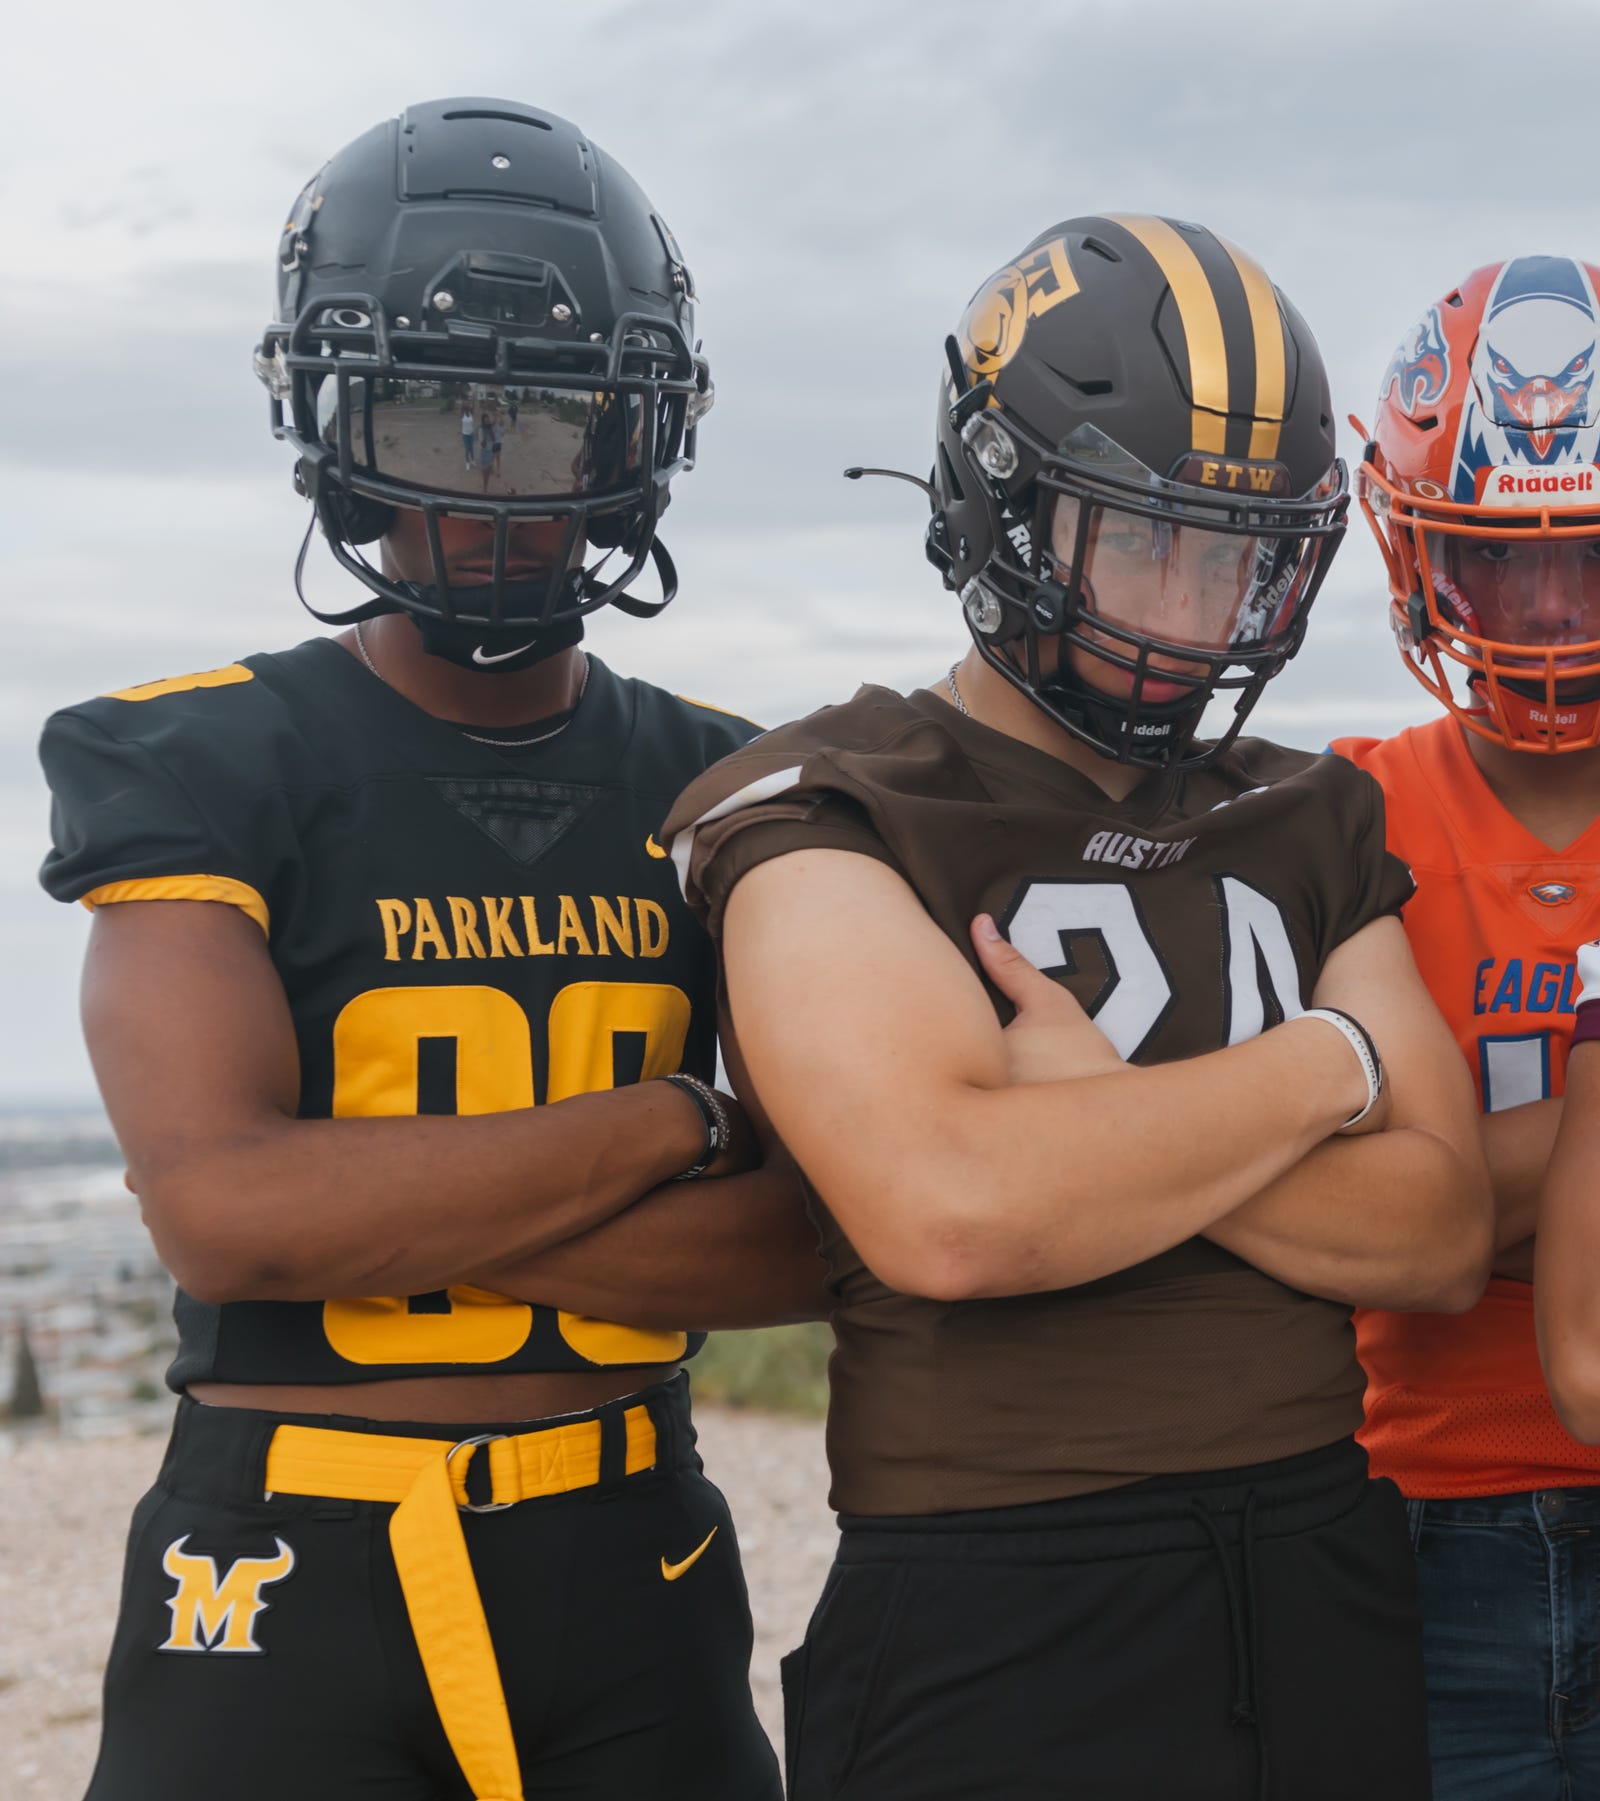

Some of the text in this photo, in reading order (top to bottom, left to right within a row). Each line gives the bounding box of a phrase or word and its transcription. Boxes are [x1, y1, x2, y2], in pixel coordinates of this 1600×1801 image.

[1497, 470, 1593, 494] Riddell
[1082, 830, 1198, 870] AUSTIN
[375, 894, 671, 962] PARKLAND
